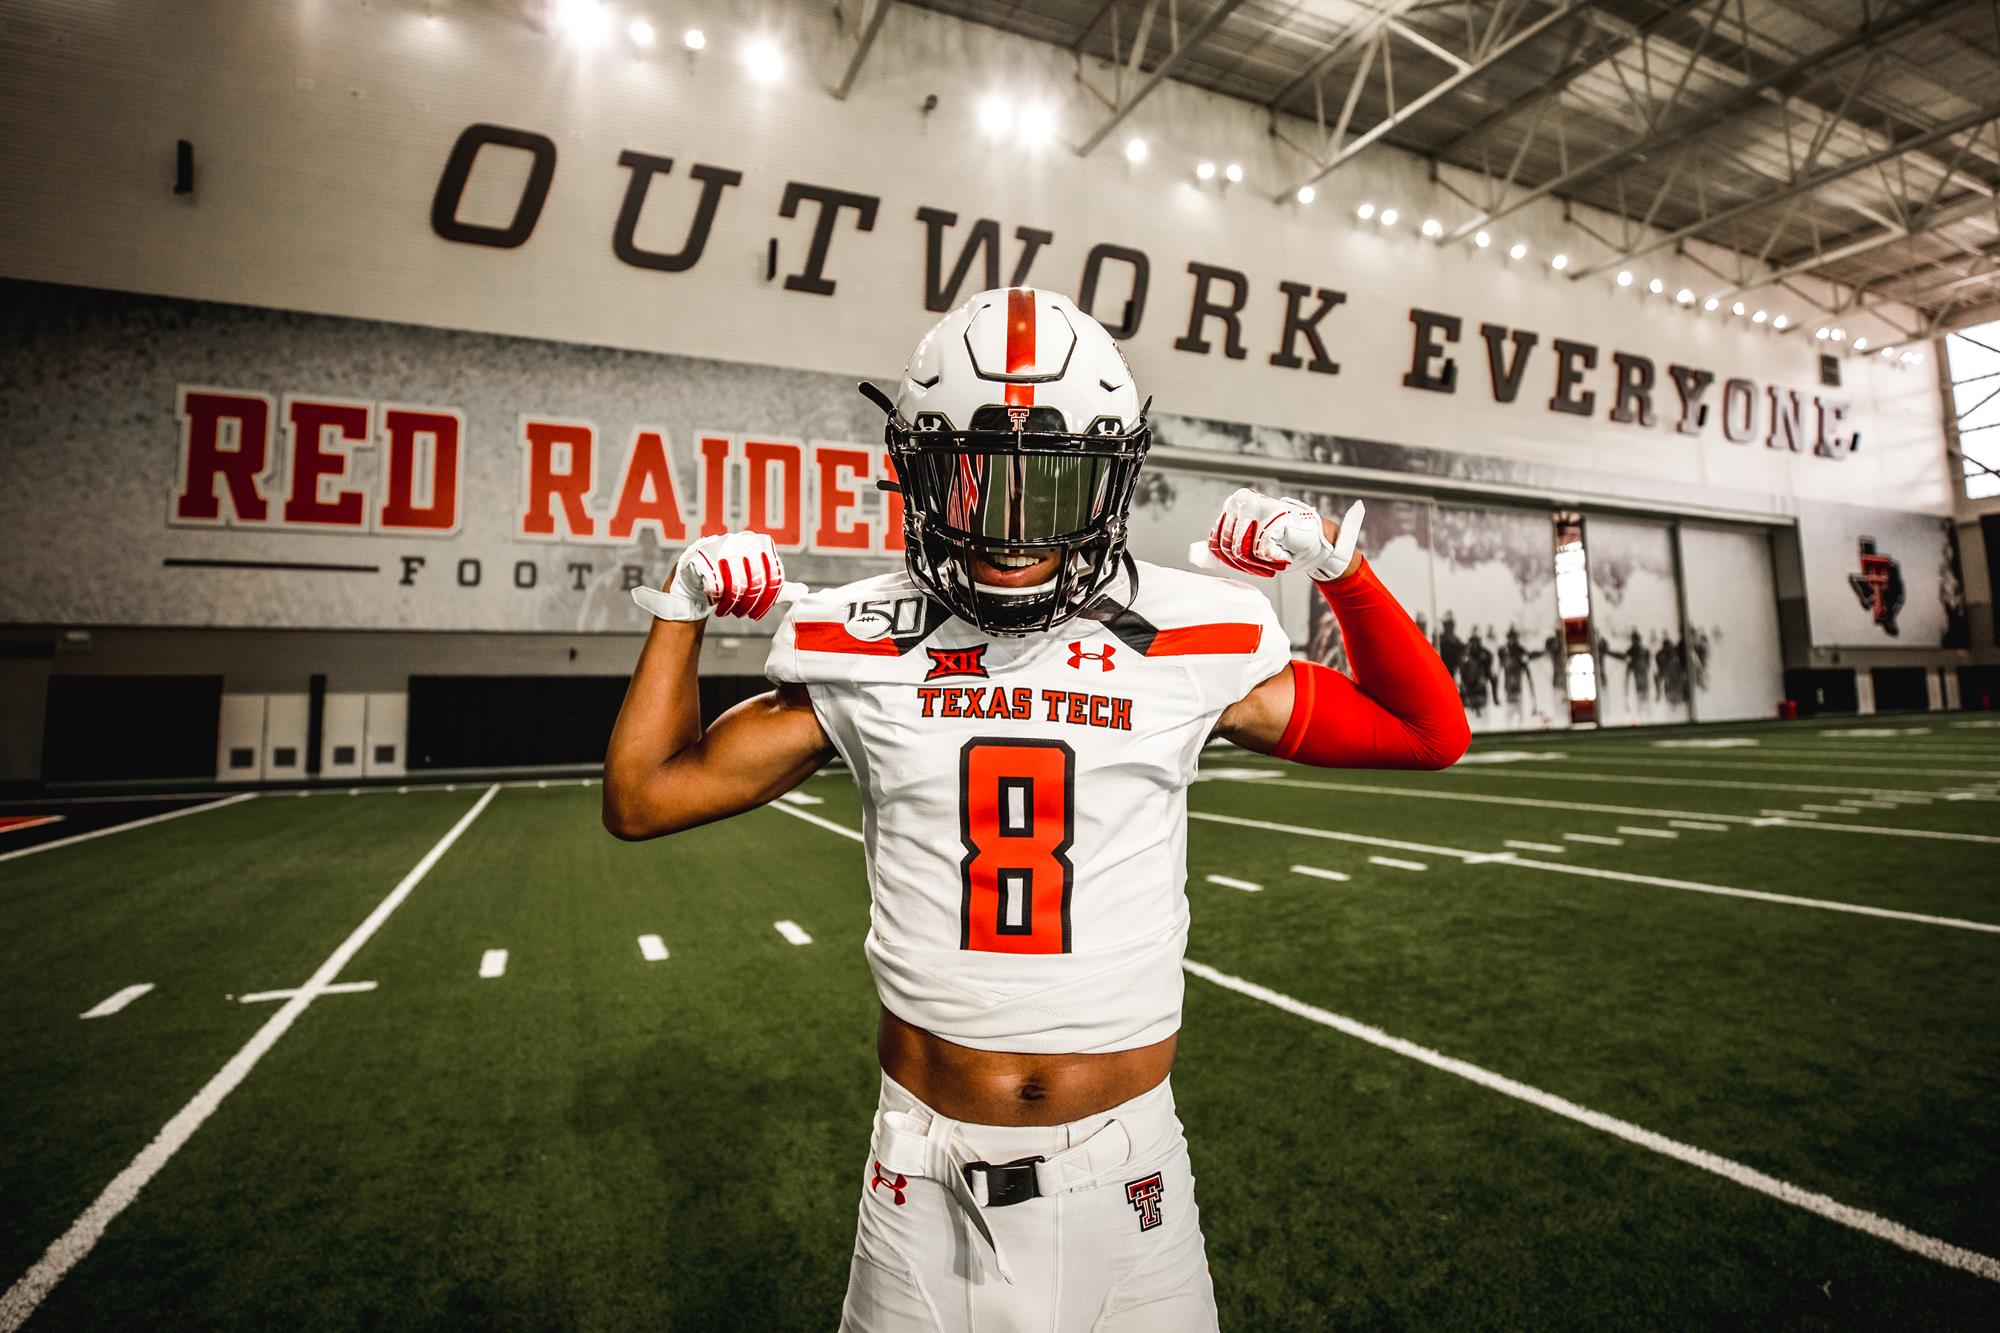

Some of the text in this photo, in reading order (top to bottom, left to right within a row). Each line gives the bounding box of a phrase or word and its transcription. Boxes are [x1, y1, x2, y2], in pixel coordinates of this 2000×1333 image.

[430, 122, 1852, 459] OUTWORK EVERYONE
[172, 385, 908, 557] RED RAIDE
[917, 687, 1132, 731] TEXAS TECH
[960, 736, 1076, 954] 8
